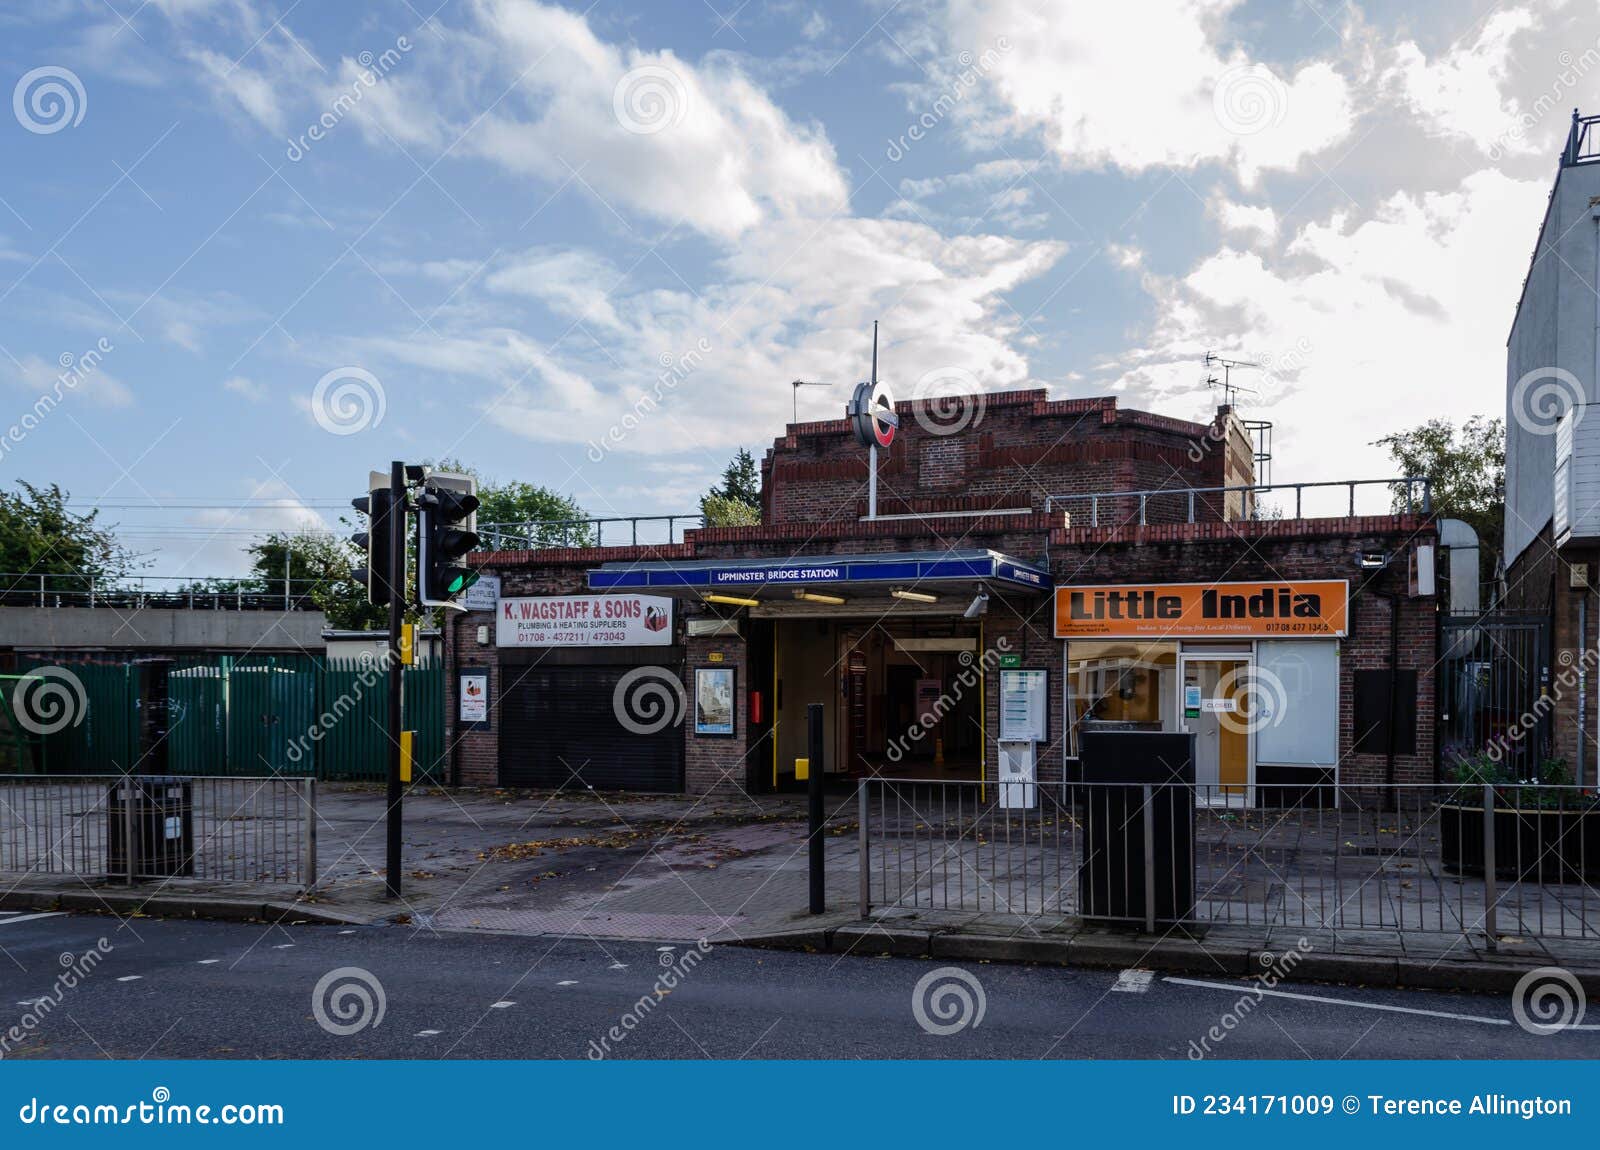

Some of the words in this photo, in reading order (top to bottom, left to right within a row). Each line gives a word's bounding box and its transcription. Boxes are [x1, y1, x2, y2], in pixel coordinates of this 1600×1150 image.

[718, 572, 764, 581] UPMINSTER
[768, 570, 799, 579] BRIDGE
[800, 568, 839, 578] STATION
[504, 602, 518, 620] K.
[520, 601, 590, 620] WAGSTAFF
[592, 601, 602, 619] &
[605, 599, 641, 619] SONS
[1070, 590, 1182, 620] Little
[1202, 588, 1321, 619] India
[517, 621, 552, 630] PLUMBING
[559, 621, 589, 629] HEATING
[589, 620, 627, 629] SUPPLIERS
[1292, 623, 1306, 631] 477
[518, 632, 545, 642] 01708
[553, 632, 585, 642] 437211
[592, 631, 625, 641] 473043
